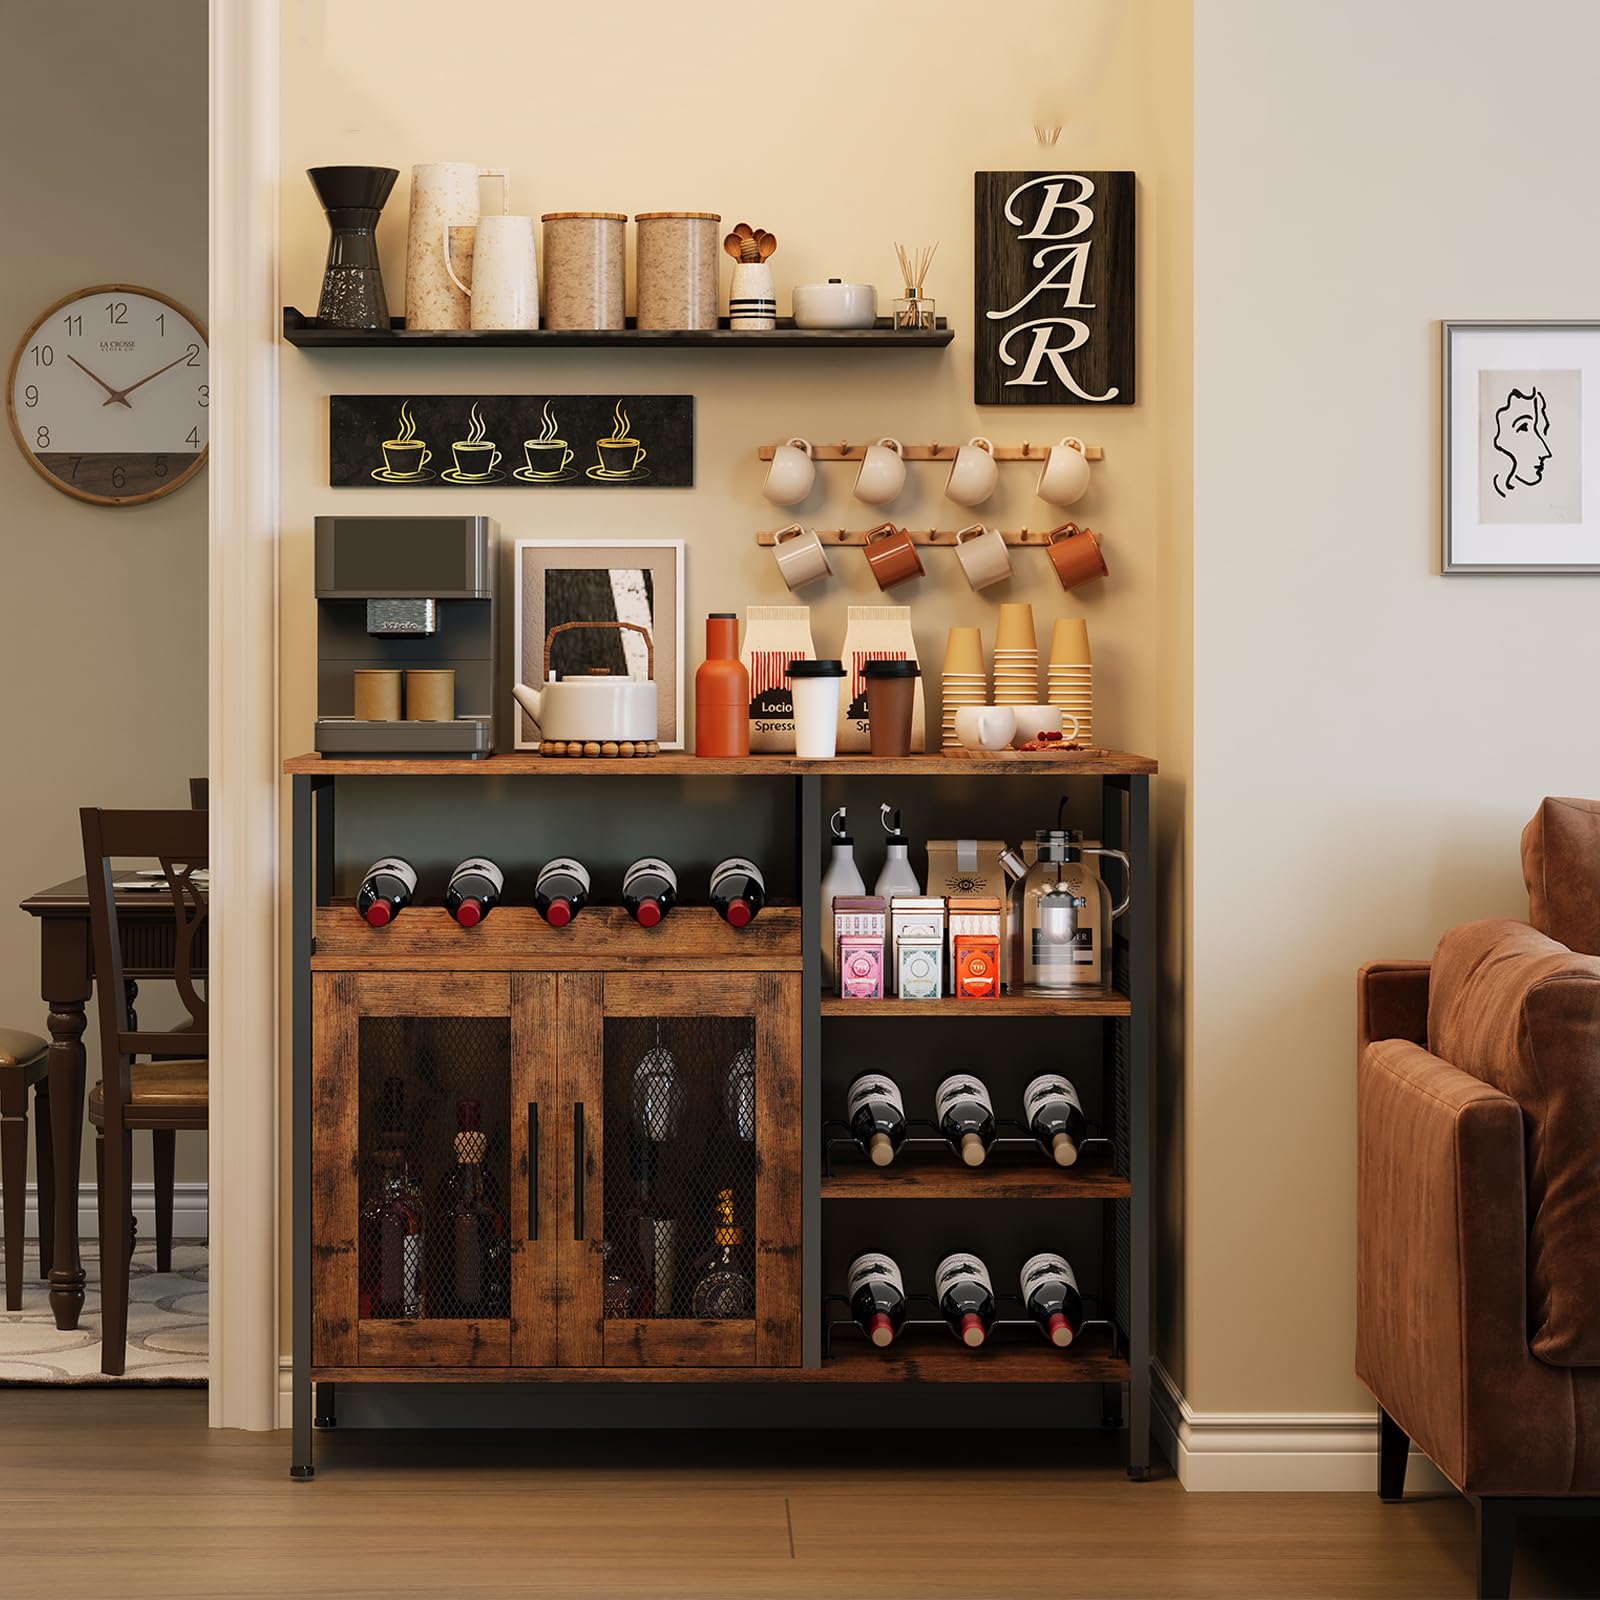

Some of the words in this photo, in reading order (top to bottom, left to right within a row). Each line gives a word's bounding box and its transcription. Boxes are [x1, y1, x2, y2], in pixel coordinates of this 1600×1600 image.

[985, 174, 1119, 402] BAR
[105, 302, 129, 324] 12
[155, 313, 165, 337] 1
[63, 315, 82, 337] 11
[31, 345, 54, 367] 10
[186, 343, 201, 367] 2
[25, 384, 39, 408] 9
[197, 384, 209, 408] 3
[36, 425, 51, 449] 8
[184, 425, 201, 449] 4
[68, 456, 82, 480] 7
[111, 466, 126, 489] 6
[154, 455, 169, 478] 5
